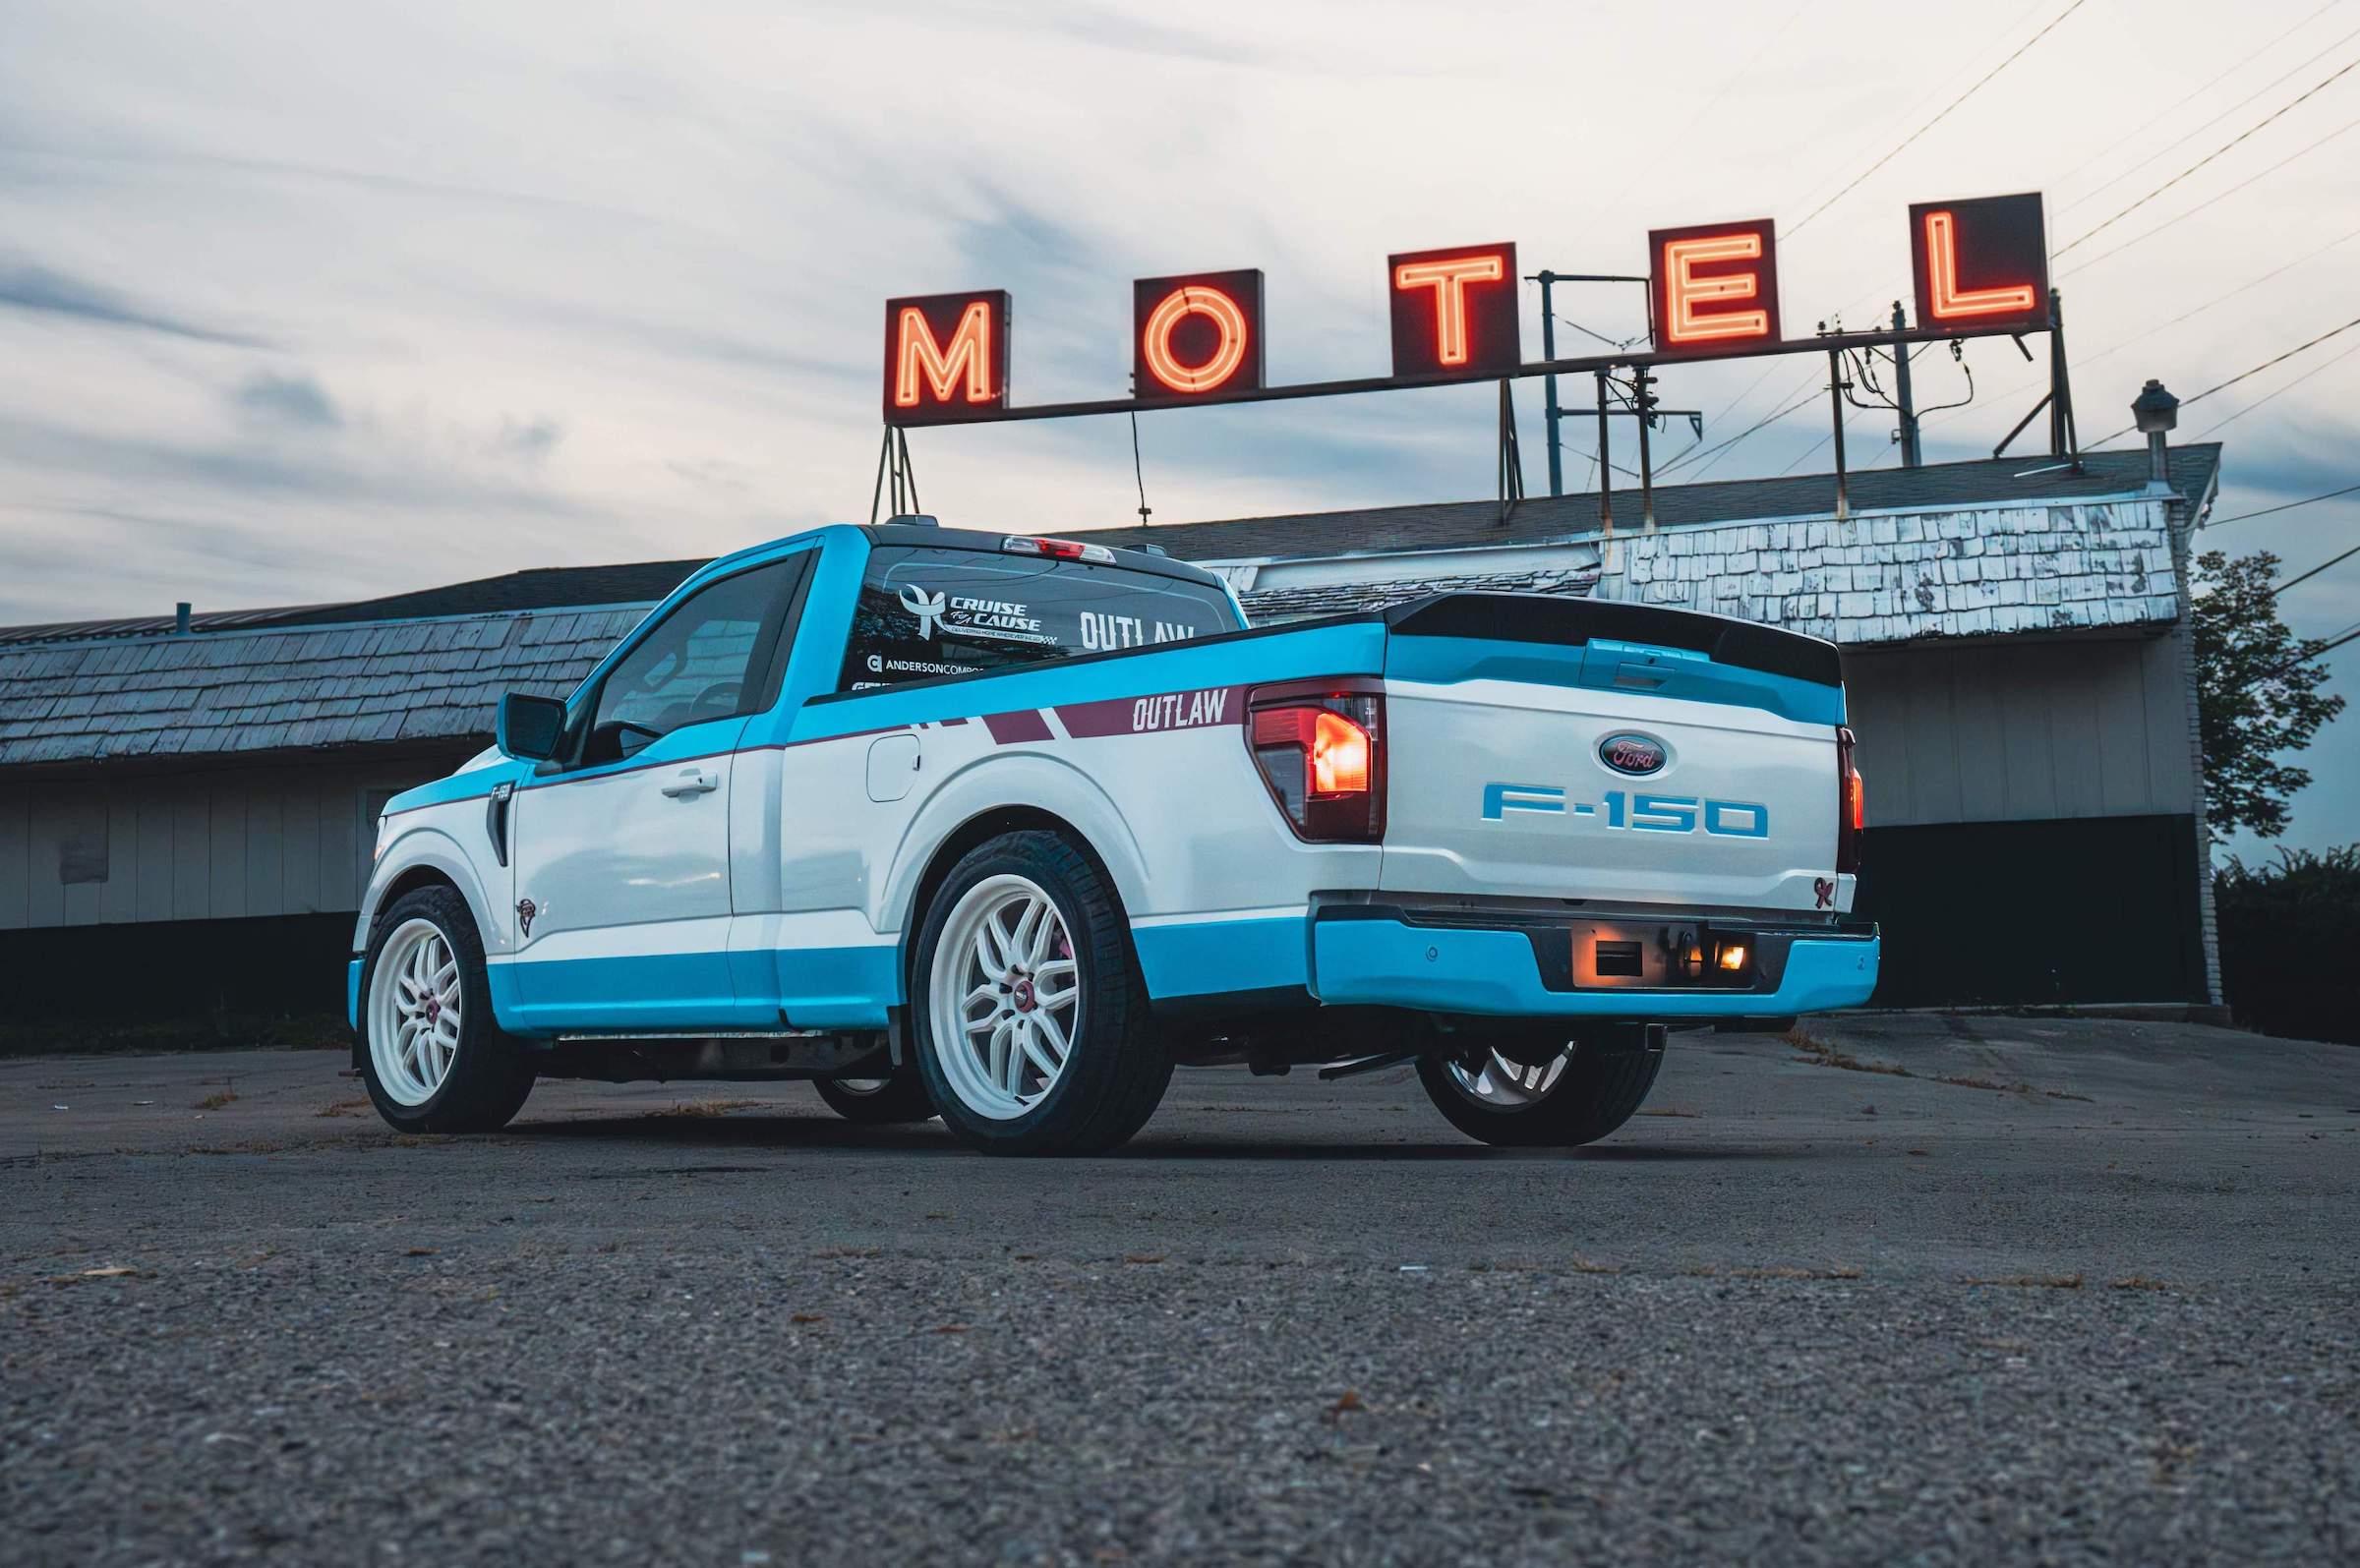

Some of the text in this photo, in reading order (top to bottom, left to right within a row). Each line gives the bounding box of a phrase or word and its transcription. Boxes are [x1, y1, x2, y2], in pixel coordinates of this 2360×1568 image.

[893, 209, 2036, 408] MOTEL
[949, 596, 1028, 617] CRUISE
[973, 612, 1042, 632] CAUSE
[1132, 687, 1229, 732] OUTLAW
[1613, 739, 1656, 769] Ford
[491, 784, 511, 801] F-150
[1480, 782, 1770, 841] F-150
